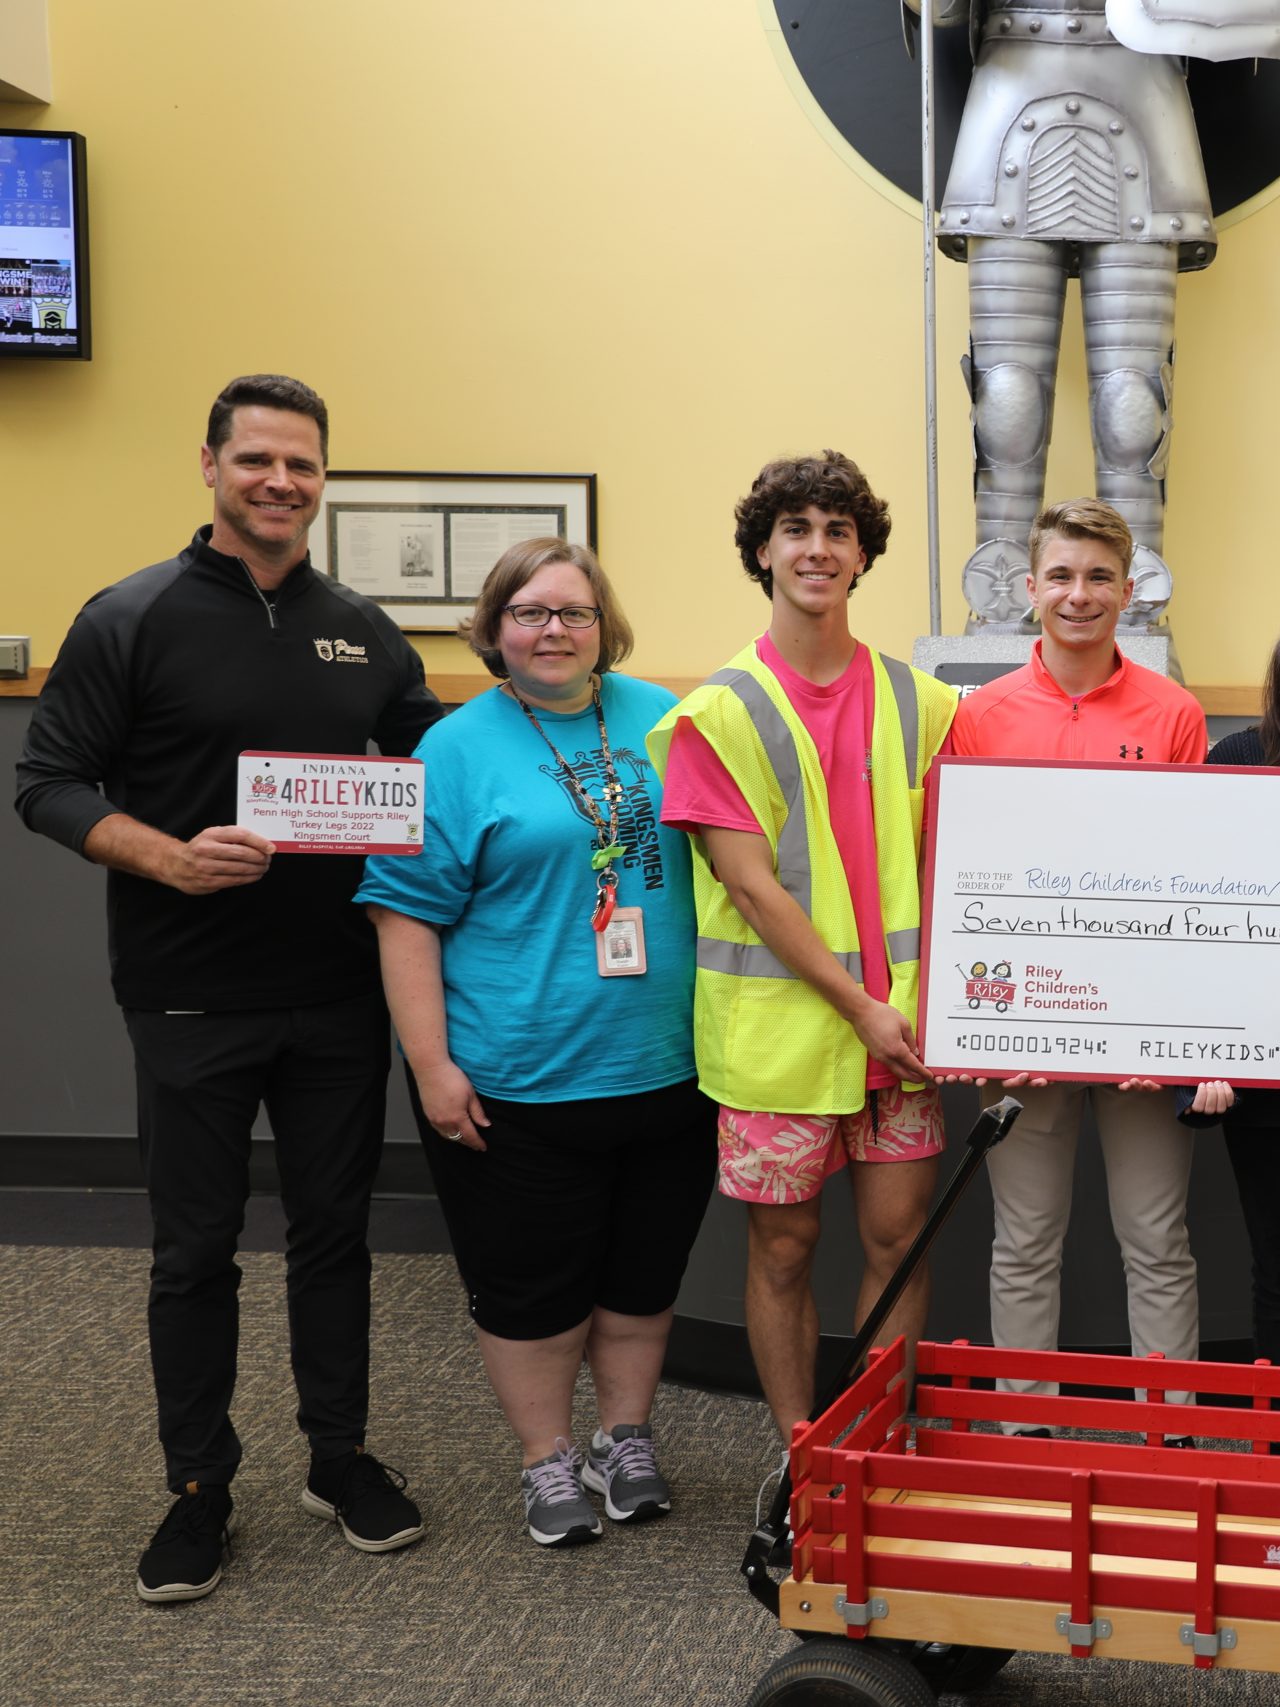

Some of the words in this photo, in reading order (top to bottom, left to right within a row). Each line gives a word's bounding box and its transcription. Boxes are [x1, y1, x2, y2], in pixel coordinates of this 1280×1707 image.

[0, 270, 32, 278] GSME
[302, 764, 367, 776] INDIANA
[281, 778, 417, 807] 4RILEYKIDS
[253, 808, 278, 817] Penn
[281, 809, 303, 819] High
[306, 810, 339, 819] School
[341, 811, 384, 821] Supports
[387, 812, 410, 822] Riley
[290, 820, 322, 830] Turkey
[326, 821, 348, 831] Legs
[351, 822, 375, 831] 2022
[294, 831, 341, 842] Kingsmen
[344, 833, 372, 842] Court
[626, 783, 664, 891] KINGSMEN
[957, 871, 976, 880] PAY
[977, 872, 991, 880] TO
[992, 872, 1013, 881] THE
[1025, 868, 1071, 897] Riley
[1078, 871, 1164, 893] Children's
[957, 881, 990, 890] ORDER
[991, 882, 1005, 891] OF
[961, 901, 1051, 933] Seven
[1057, 904, 1174, 936] thousand
[1184, 906, 1239, 937] four
[1025, 965, 1063, 981] Riley
[974, 983, 1009, 999] Riley
[1024, 981, 1099, 995] Children's
[1024, 996, 1108, 1011] Foundation
